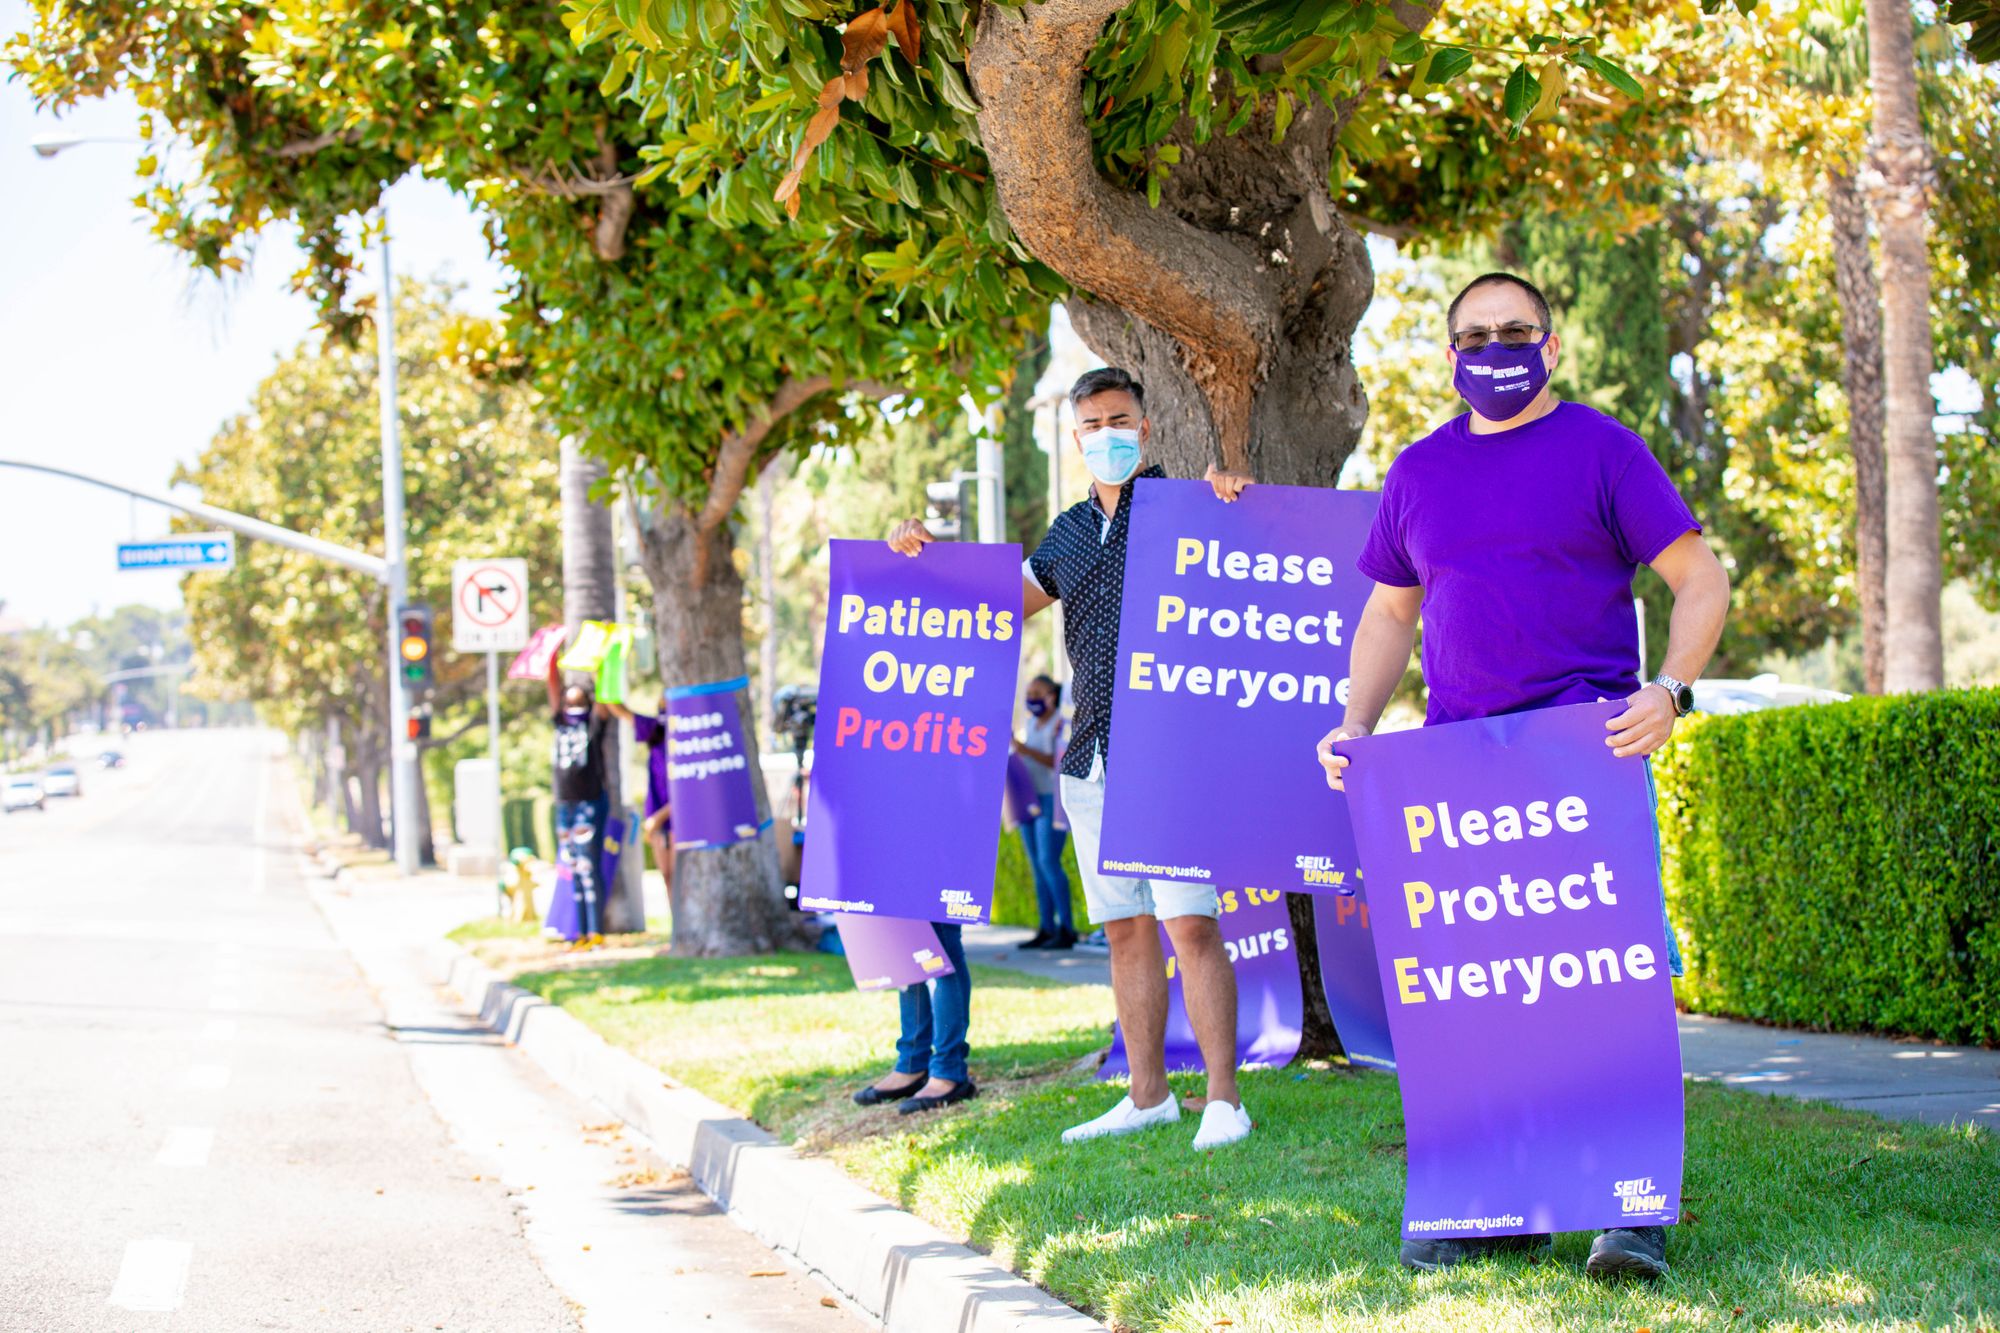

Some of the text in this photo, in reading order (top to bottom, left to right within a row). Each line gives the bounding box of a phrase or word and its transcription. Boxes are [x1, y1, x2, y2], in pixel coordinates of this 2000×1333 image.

[1175, 538, 1333, 585] Please
[838, 595, 1014, 641] Patients
[1156, 595, 1343, 646] Protect
[863, 650, 974, 696] Over
[835, 707, 988, 757] Profits
[1403, 796, 1589, 853] Please
[1304, 869, 1345, 885] UHW
[1403, 861, 1618, 929] Protect
[1223, 928, 1289, 963] ours
[1393, 943, 1657, 1005] Everyone
[1408, 1213, 1524, 1232] #HealthcareJustice
[1622, 1194, 1667, 1212] UHW
